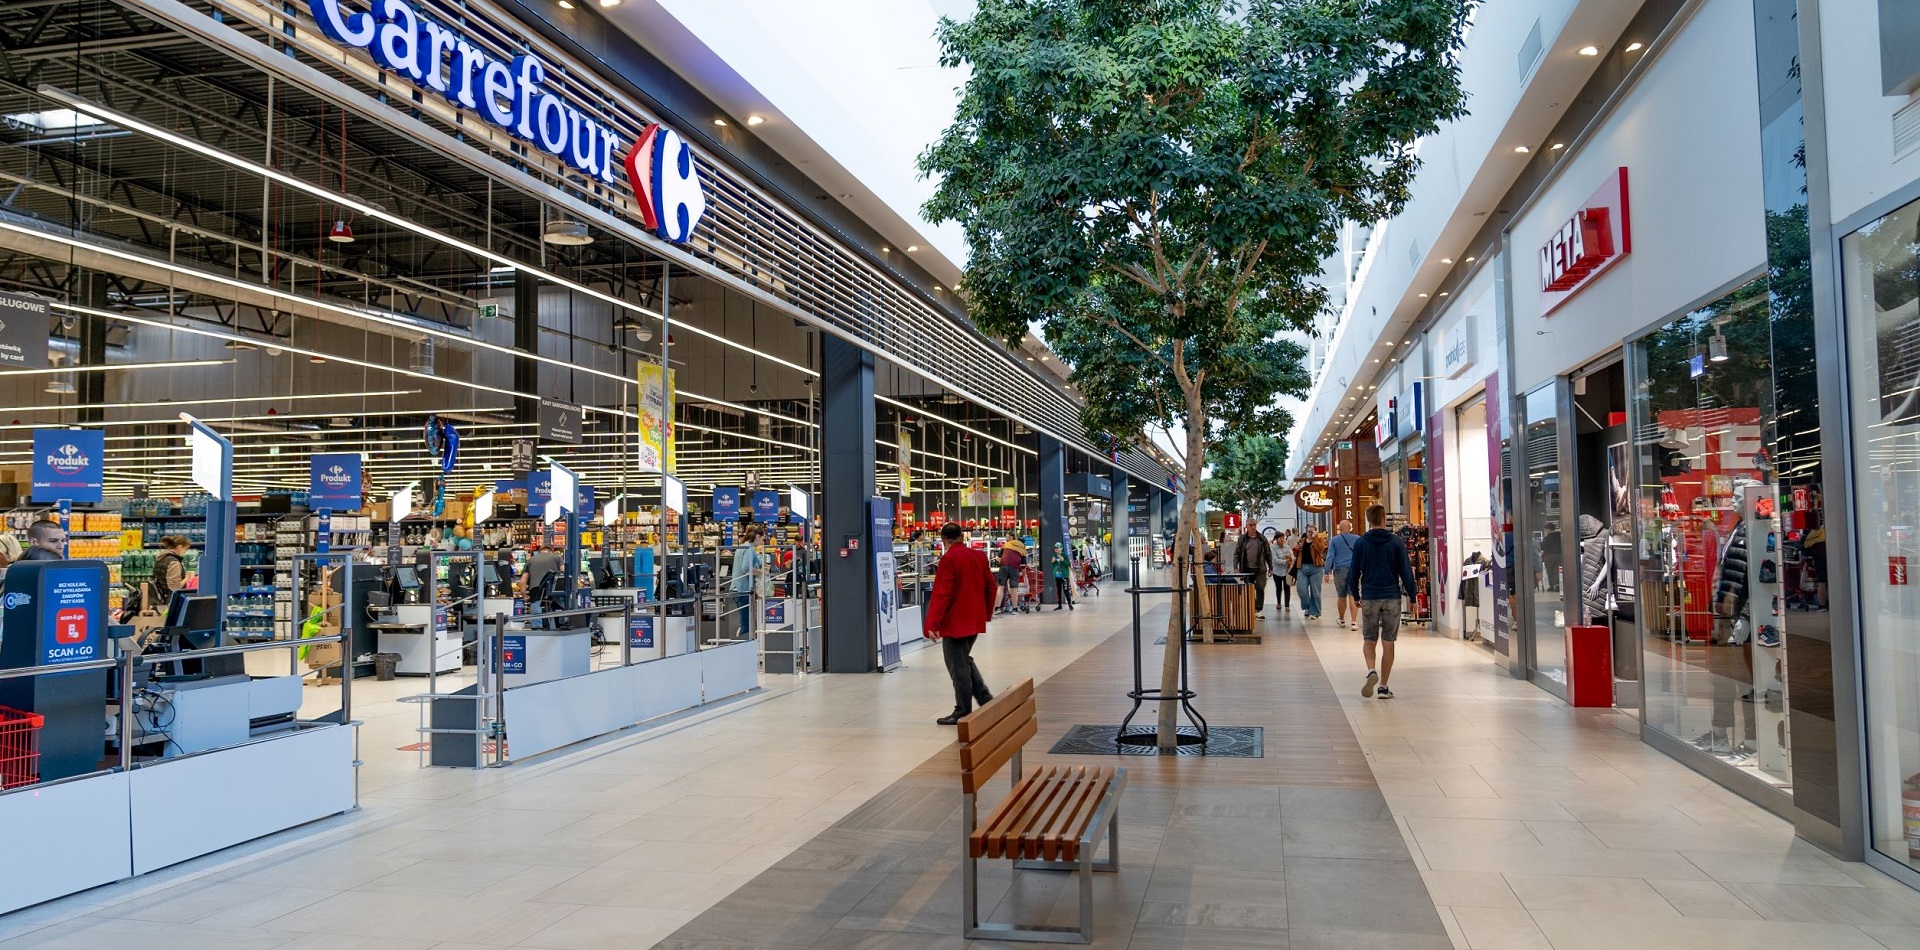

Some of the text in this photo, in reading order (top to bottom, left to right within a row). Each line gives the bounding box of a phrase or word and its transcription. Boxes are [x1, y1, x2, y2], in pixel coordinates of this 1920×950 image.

[310, 0, 620, 184] Carrefour
[1540, 213, 1586, 293] META
[47, 455, 89, 466] Produkt
[320, 473, 351, 482] Produkt
[48, 648, 74, 658] SCAN
[79, 645, 93, 655] GO
